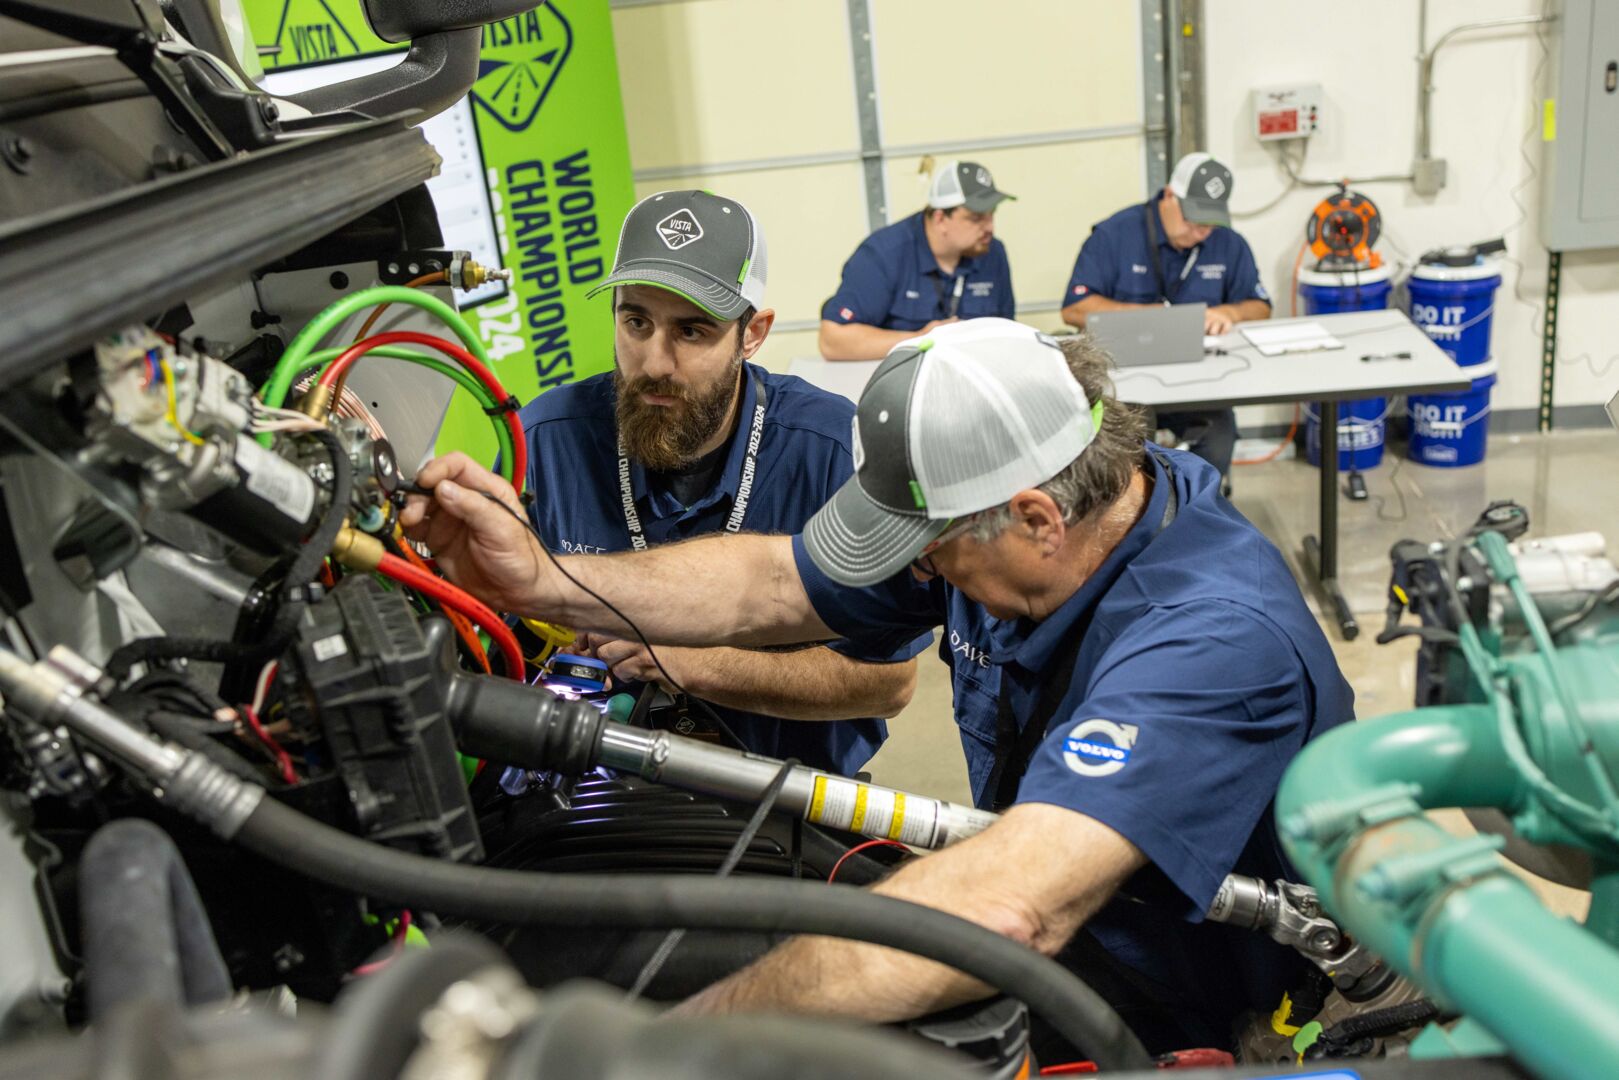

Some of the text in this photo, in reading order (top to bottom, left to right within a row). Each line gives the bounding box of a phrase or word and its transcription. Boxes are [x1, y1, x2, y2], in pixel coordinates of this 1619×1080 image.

[288, 23, 340, 62] VISTA
[552, 149, 605, 285] WORLD
[669, 218, 692, 232] VISTA
[1443, 306, 1467, 325] IT
[725, 404, 766, 533] CHAMPIONSHIP 2023-2024
[618, 458, 642, 534] CHAMPIONSHIP
[949, 629, 992, 670] DAVE
[1067, 740, 1126, 761] VOLVO
